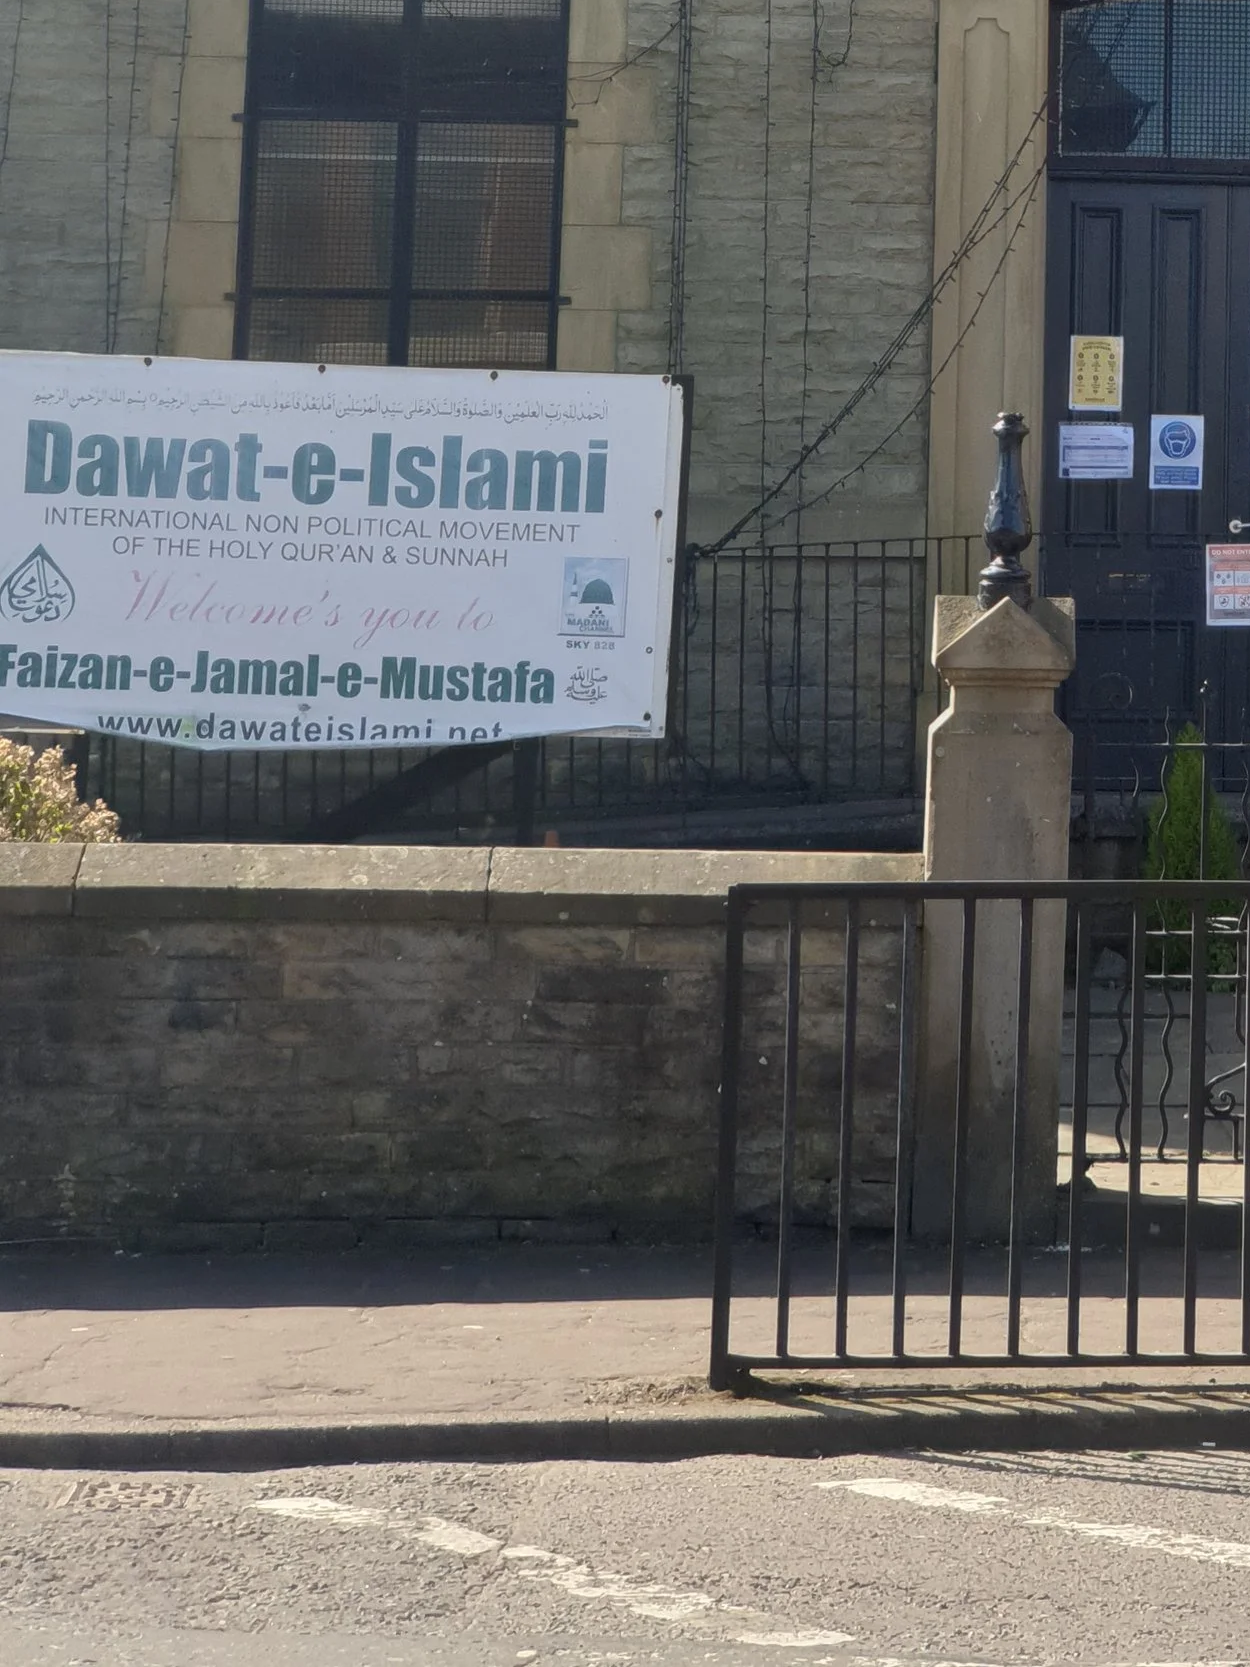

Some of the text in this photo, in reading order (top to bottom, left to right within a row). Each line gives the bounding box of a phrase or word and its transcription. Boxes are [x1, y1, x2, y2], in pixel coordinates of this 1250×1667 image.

[24, 419, 609, 514] Dawat-e-Islami
[44, 506, 581, 543] INTERNATIONAL NON POLITICAL MOVEMENT
[112, 536, 145, 555] OF
[153, 537, 200, 557] THE
[208, 539, 273, 561] HOLY
[382, 545, 397, 564] &
[405, 546, 508, 568] SUNNAH
[124, 568, 496, 650] Welcome's you to
[567, 618, 610, 627] MADANI
[566, 640, 590, 650] SKY
[0, 643, 555, 705] Faizan-e-Jamal-e-Mustafa
[98, 713, 503, 743] www.dawateislaminet
